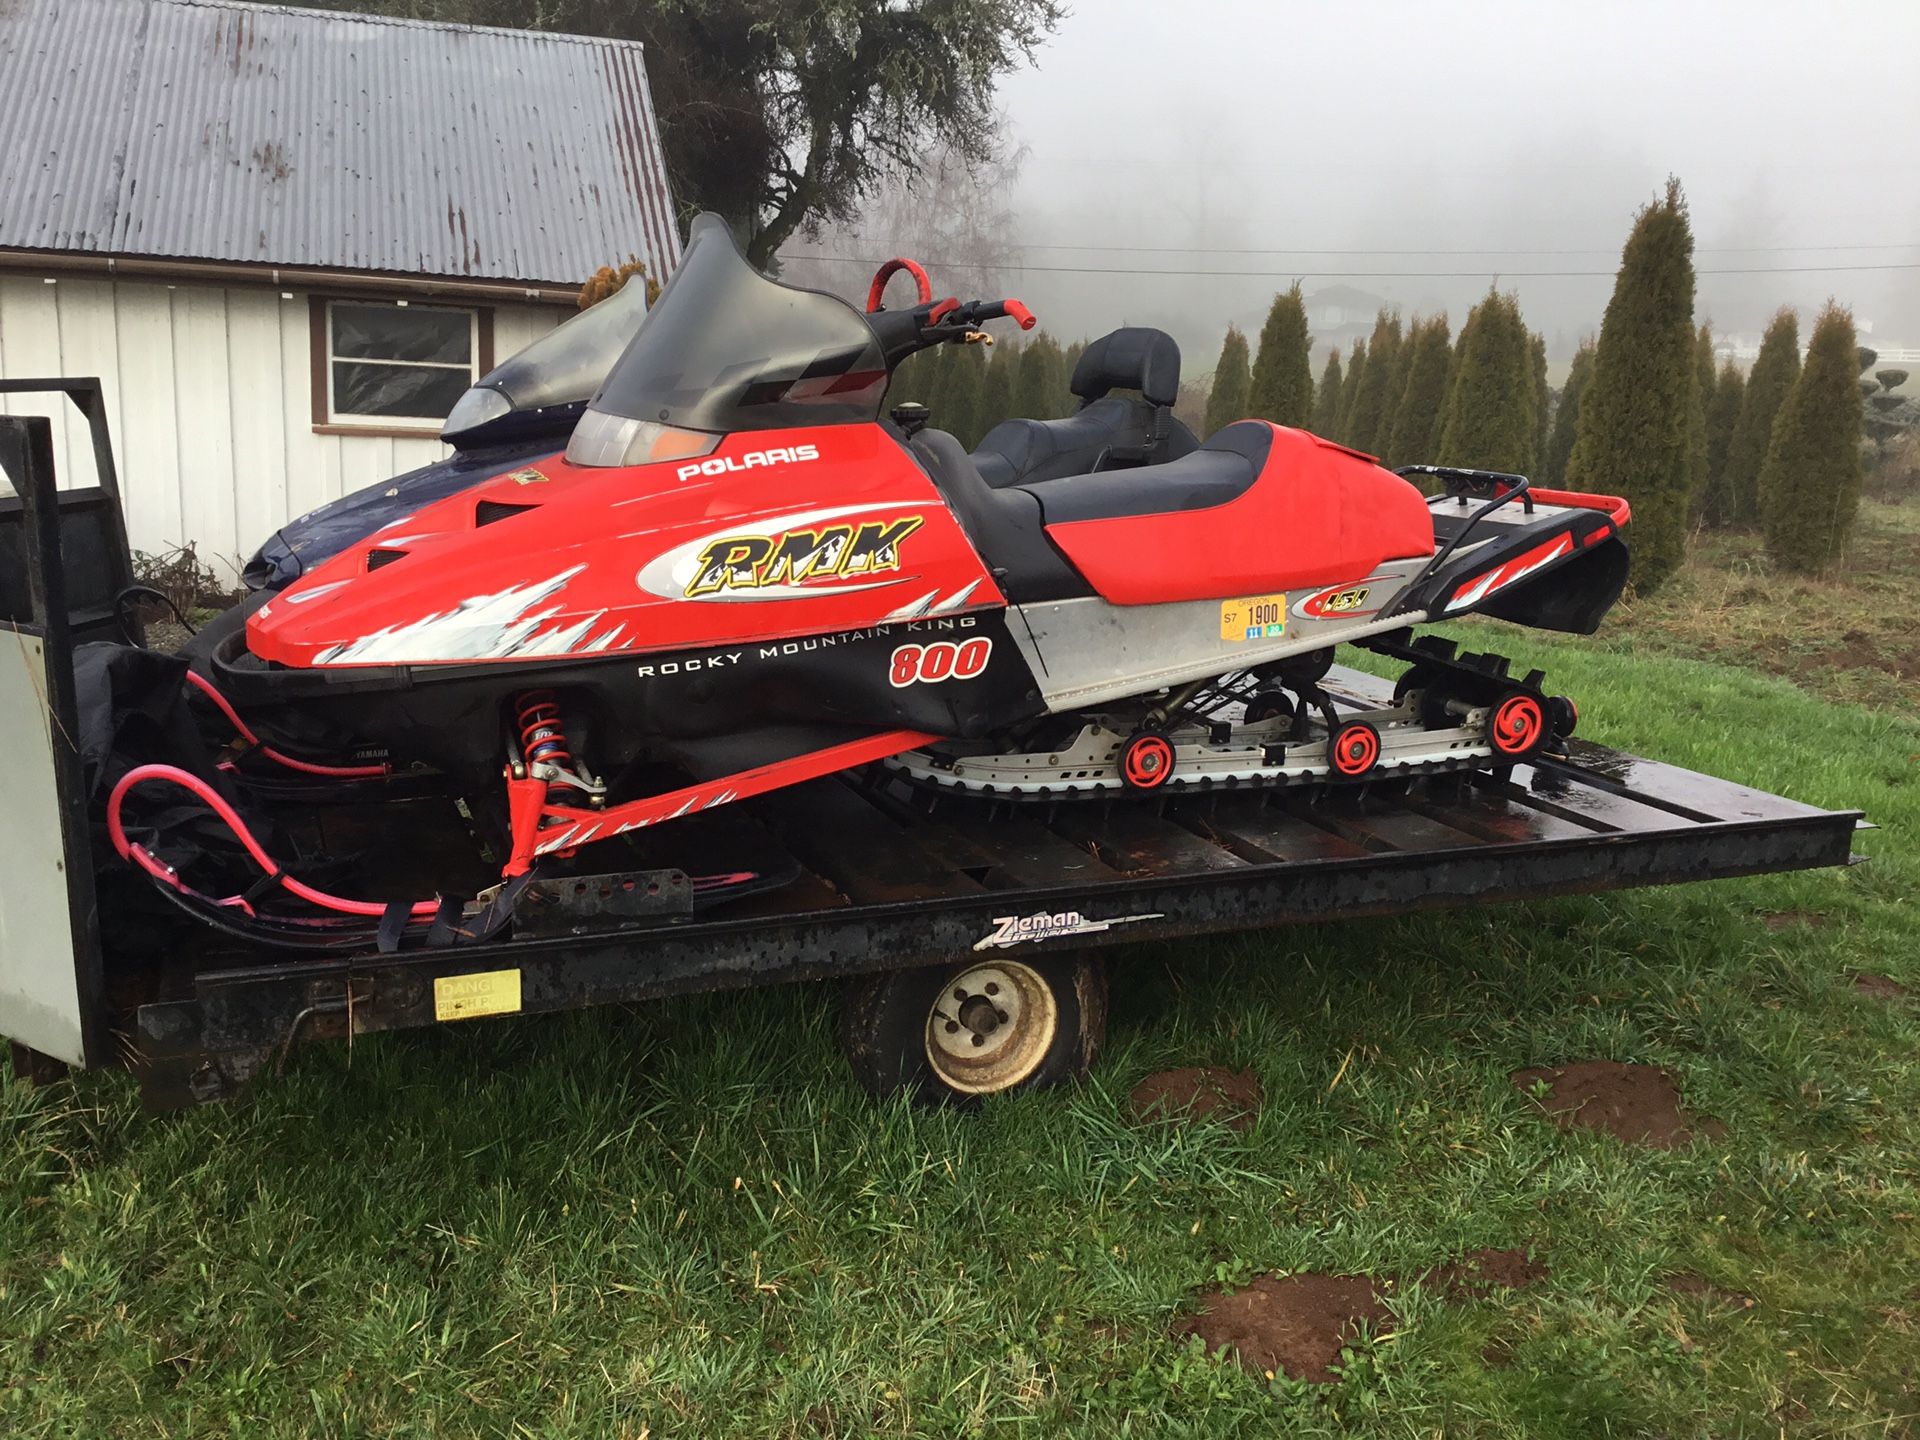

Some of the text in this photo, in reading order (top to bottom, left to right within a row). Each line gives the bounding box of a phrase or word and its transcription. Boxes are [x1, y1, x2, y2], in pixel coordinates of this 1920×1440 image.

[676, 444, 820, 482] POLARIS
[684, 514, 925, 599] RMK
[1223, 603, 1278, 625] S7 1900
[1320, 588, 1370, 613] 151
[637, 616, 977, 678] ROCKY MOUNTAIN KING
[1249, 627, 1259, 638] 11
[889, 636, 993, 688] 800
[355, 749, 389, 759] YAMAHA
[993, 911, 1080, 944] Zieman
